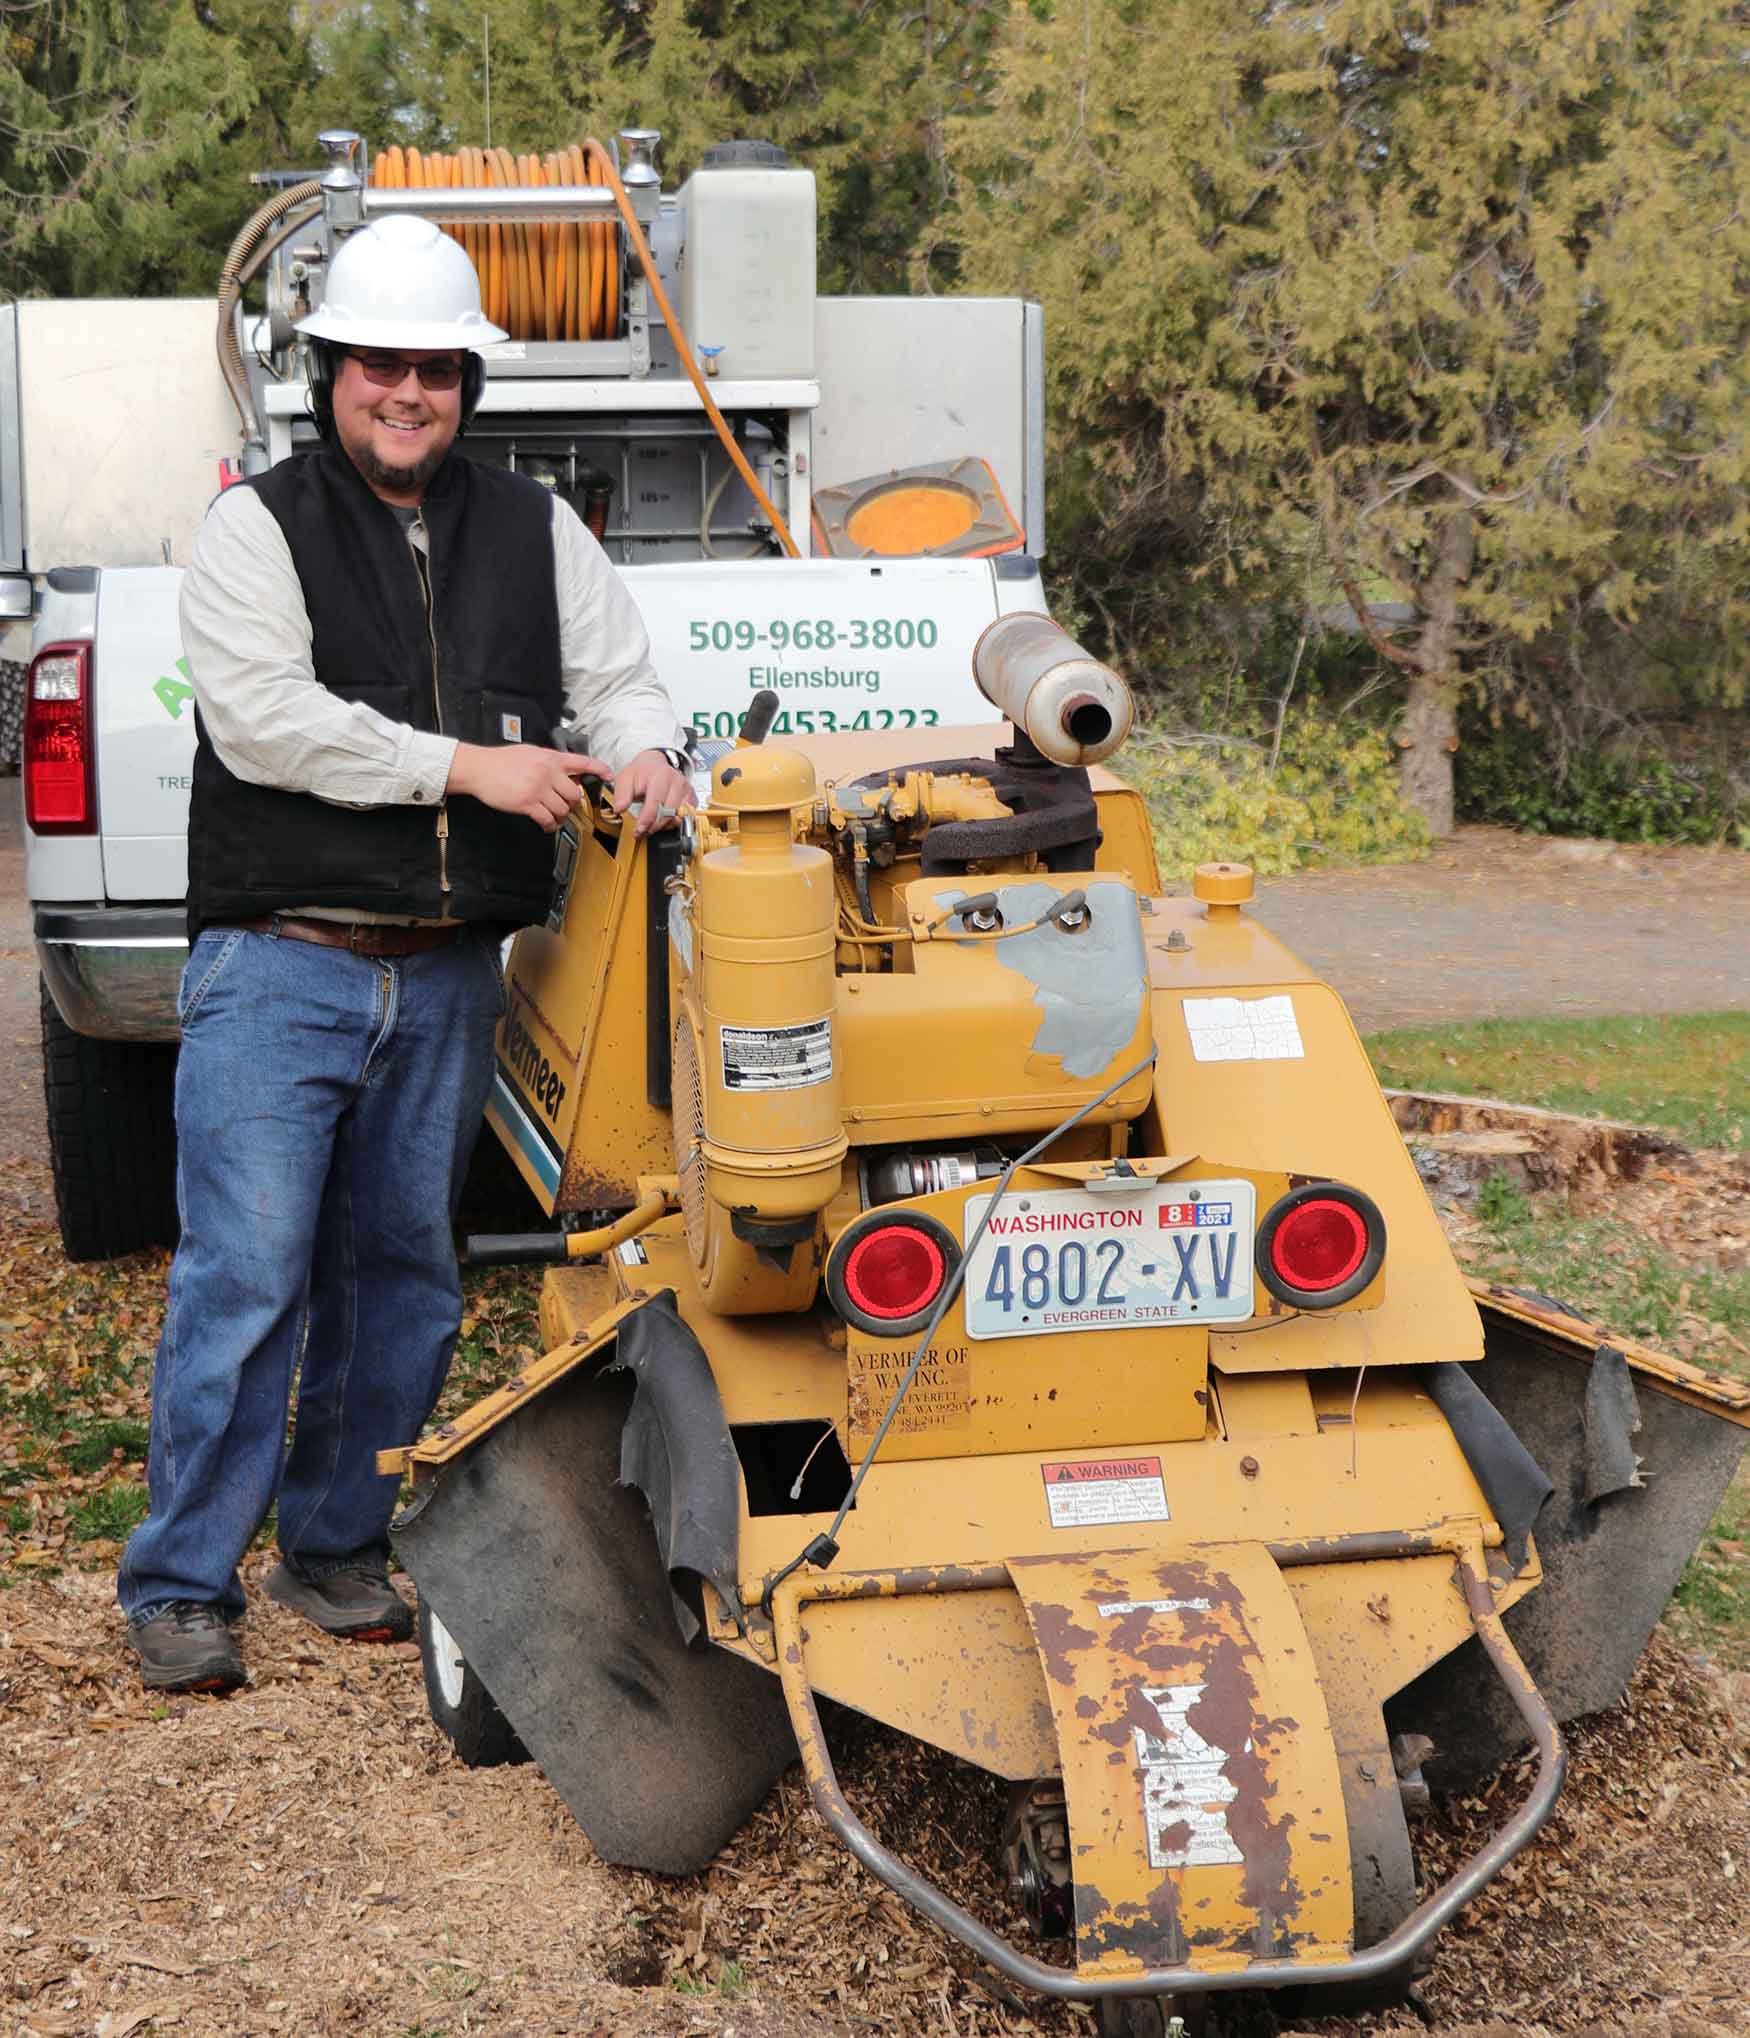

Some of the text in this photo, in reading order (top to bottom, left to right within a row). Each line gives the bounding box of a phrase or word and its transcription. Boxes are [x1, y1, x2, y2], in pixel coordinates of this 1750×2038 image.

[689, 618, 938, 650] 509-968-3800
[749, 666, 880, 692] Ellensburg
[691, 708, 940, 738] 50453-4223
[988, 1210, 1143, 1234] WASHINGTON
[1168, 1206, 1182, 1222] 8
[1199, 1214, 1228, 1225] 2021
[1043, 1305, 1179, 1324] EVERGREEN STATE
[945, 1347, 969, 1365] OF
[913, 1369, 949, 1387] INC.
[1078, 1463, 1149, 1479] WARNING
